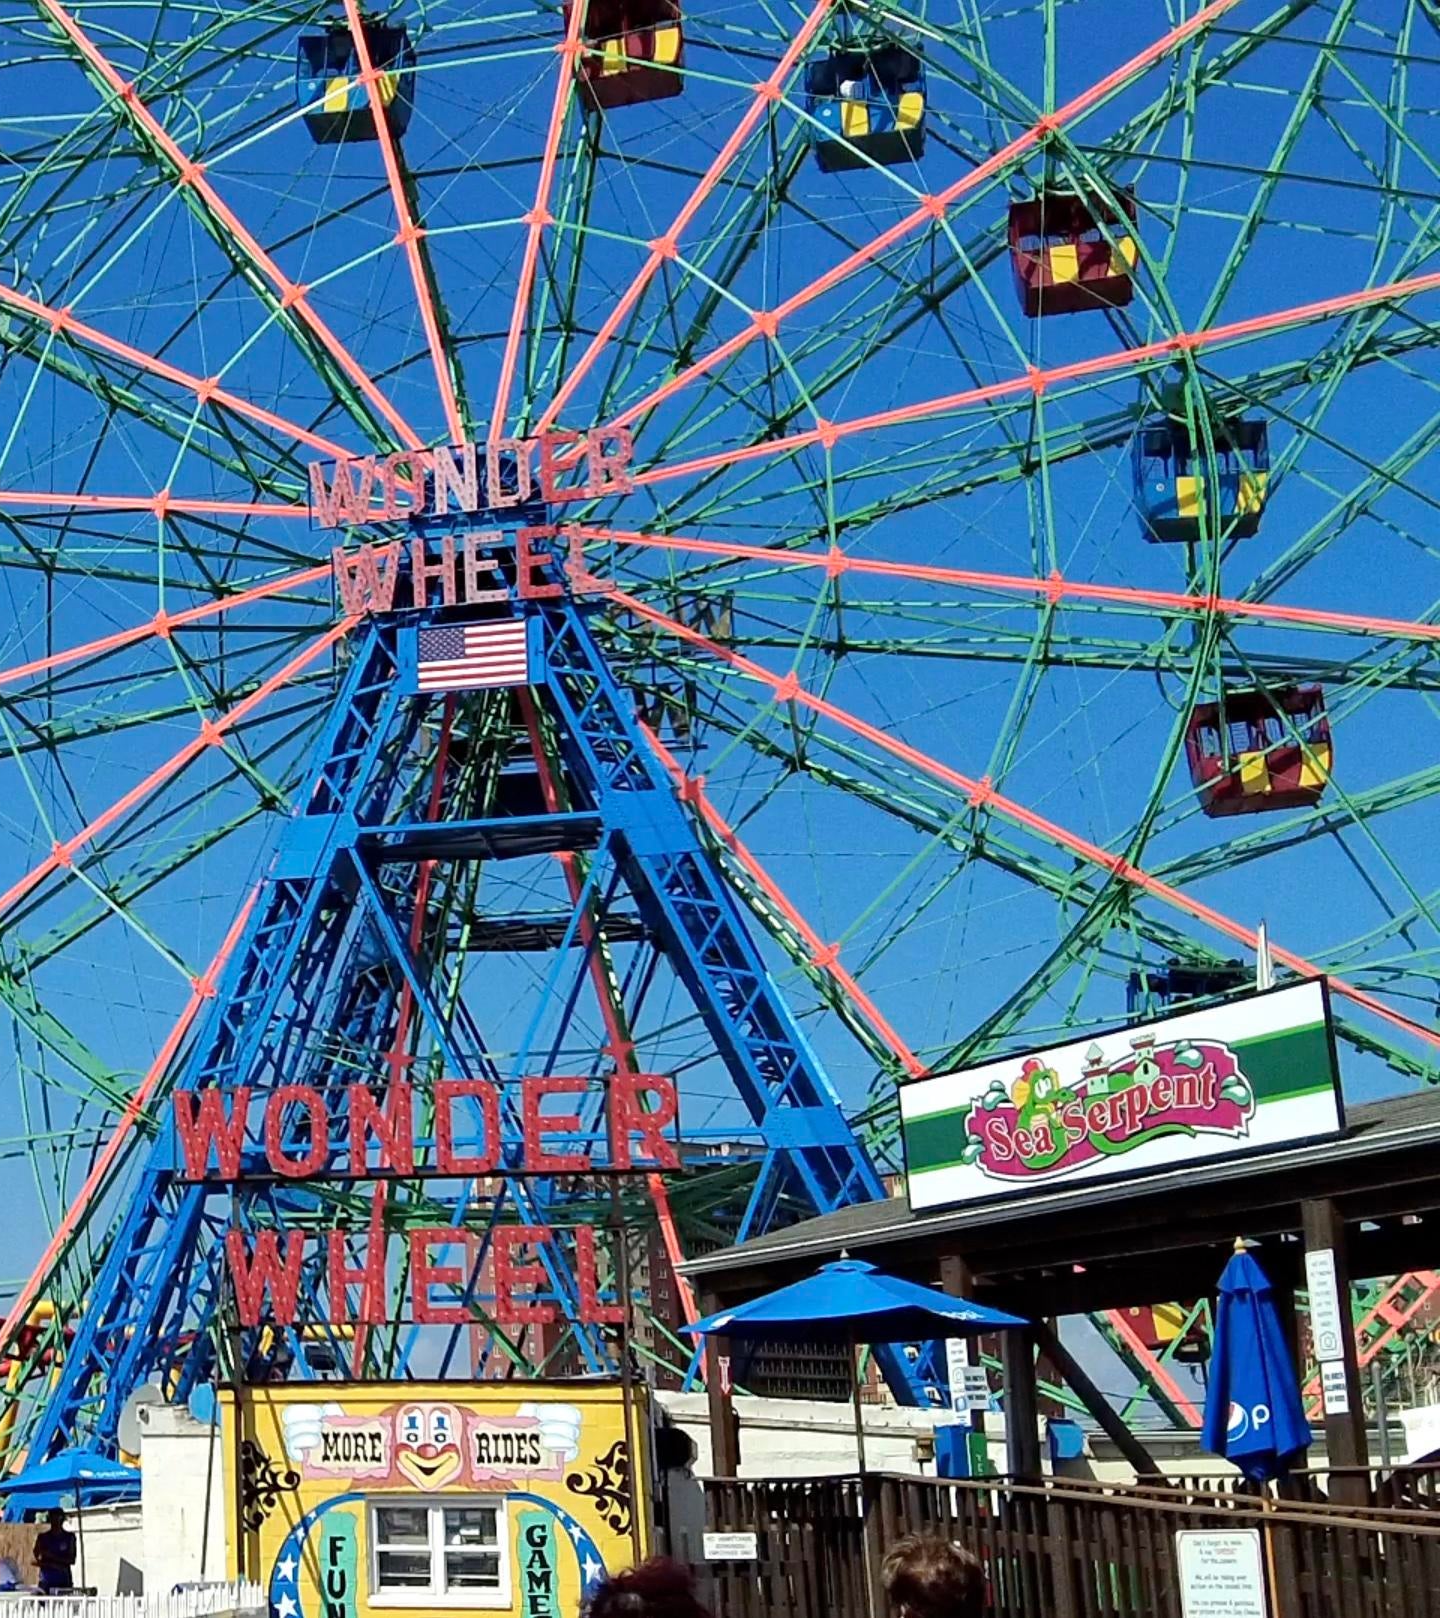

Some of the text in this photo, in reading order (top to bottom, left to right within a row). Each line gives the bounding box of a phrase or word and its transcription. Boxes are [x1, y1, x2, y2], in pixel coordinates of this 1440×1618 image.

[308, 426, 635, 528] WONDER
[331, 522, 616, 616] WHEEL
[173, 1074, 682, 1181] WONDER
[985, 1062, 1217, 1161] Sea Serpent
[225, 1224, 628, 1326] WHEEL
[321, 1431, 542, 1466] MORE RIDES
[524, 1524, 553, 1618] GAME
